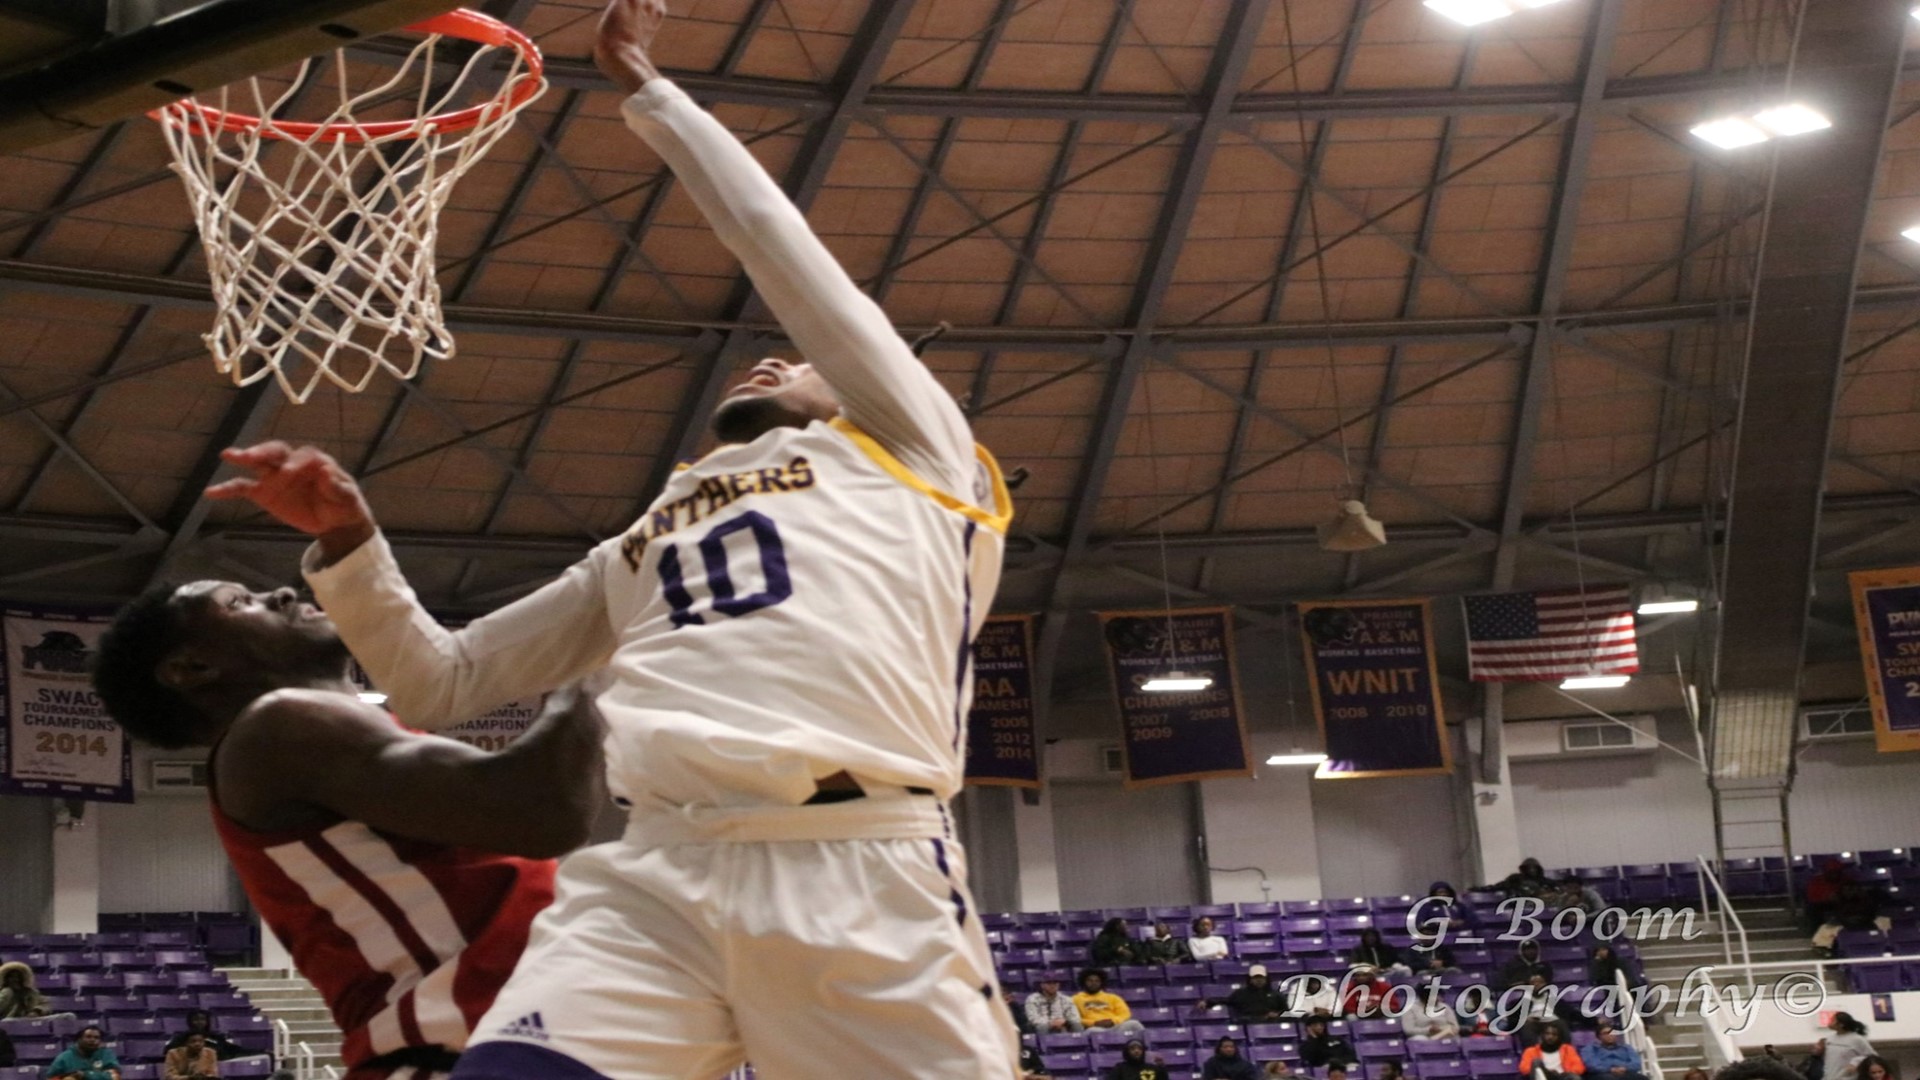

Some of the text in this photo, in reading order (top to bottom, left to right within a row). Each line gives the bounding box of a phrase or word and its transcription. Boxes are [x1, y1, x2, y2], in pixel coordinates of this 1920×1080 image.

[657, 510, 792, 629] 10
[974, 661, 1024, 671] ASKETBALL
[1327, 668, 1420, 695] WNIT
[38, 688, 100, 706] SWAC
[23, 715, 116, 731] CHAMPIONS
[36, 731, 107, 757] 2014
[456, 735, 519, 752] 201
[992, 732, 1031, 745] 2012
